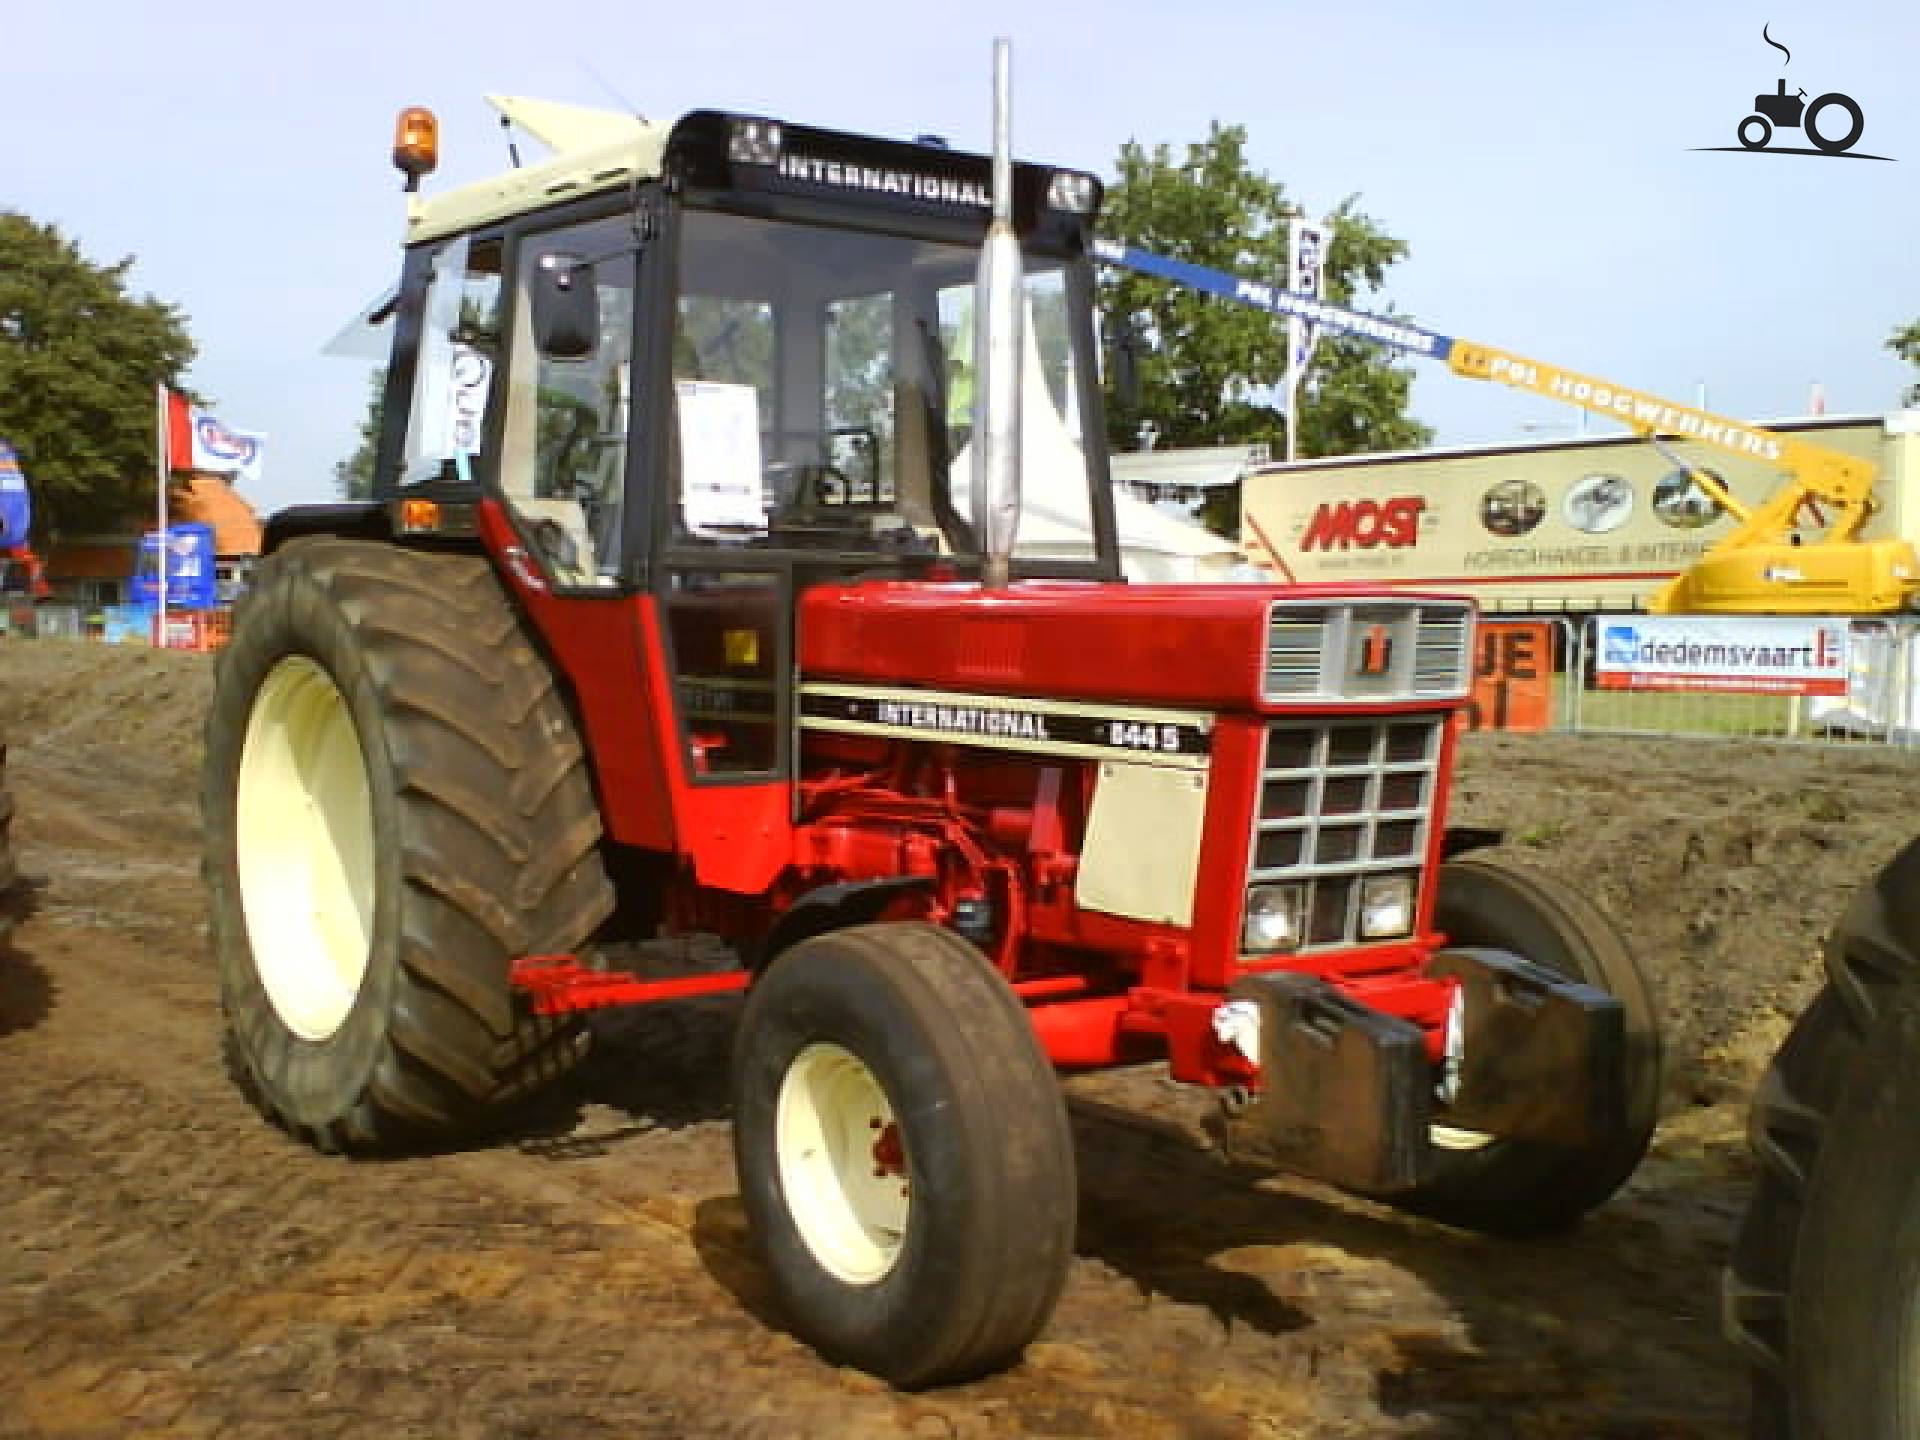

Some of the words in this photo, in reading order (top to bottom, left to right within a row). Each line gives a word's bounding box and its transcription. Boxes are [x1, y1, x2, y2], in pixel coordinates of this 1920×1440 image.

[779, 154, 992, 207] INTERNATIONAL
[1490, 355, 1537, 384] POL
[1550, 373, 1781, 460] HOOGWERKERS
[1300, 496, 1427, 552] MOST
[1639, 634, 1815, 669] dedemsvaart
[877, 700, 1049, 741] INTERNATIONAL
